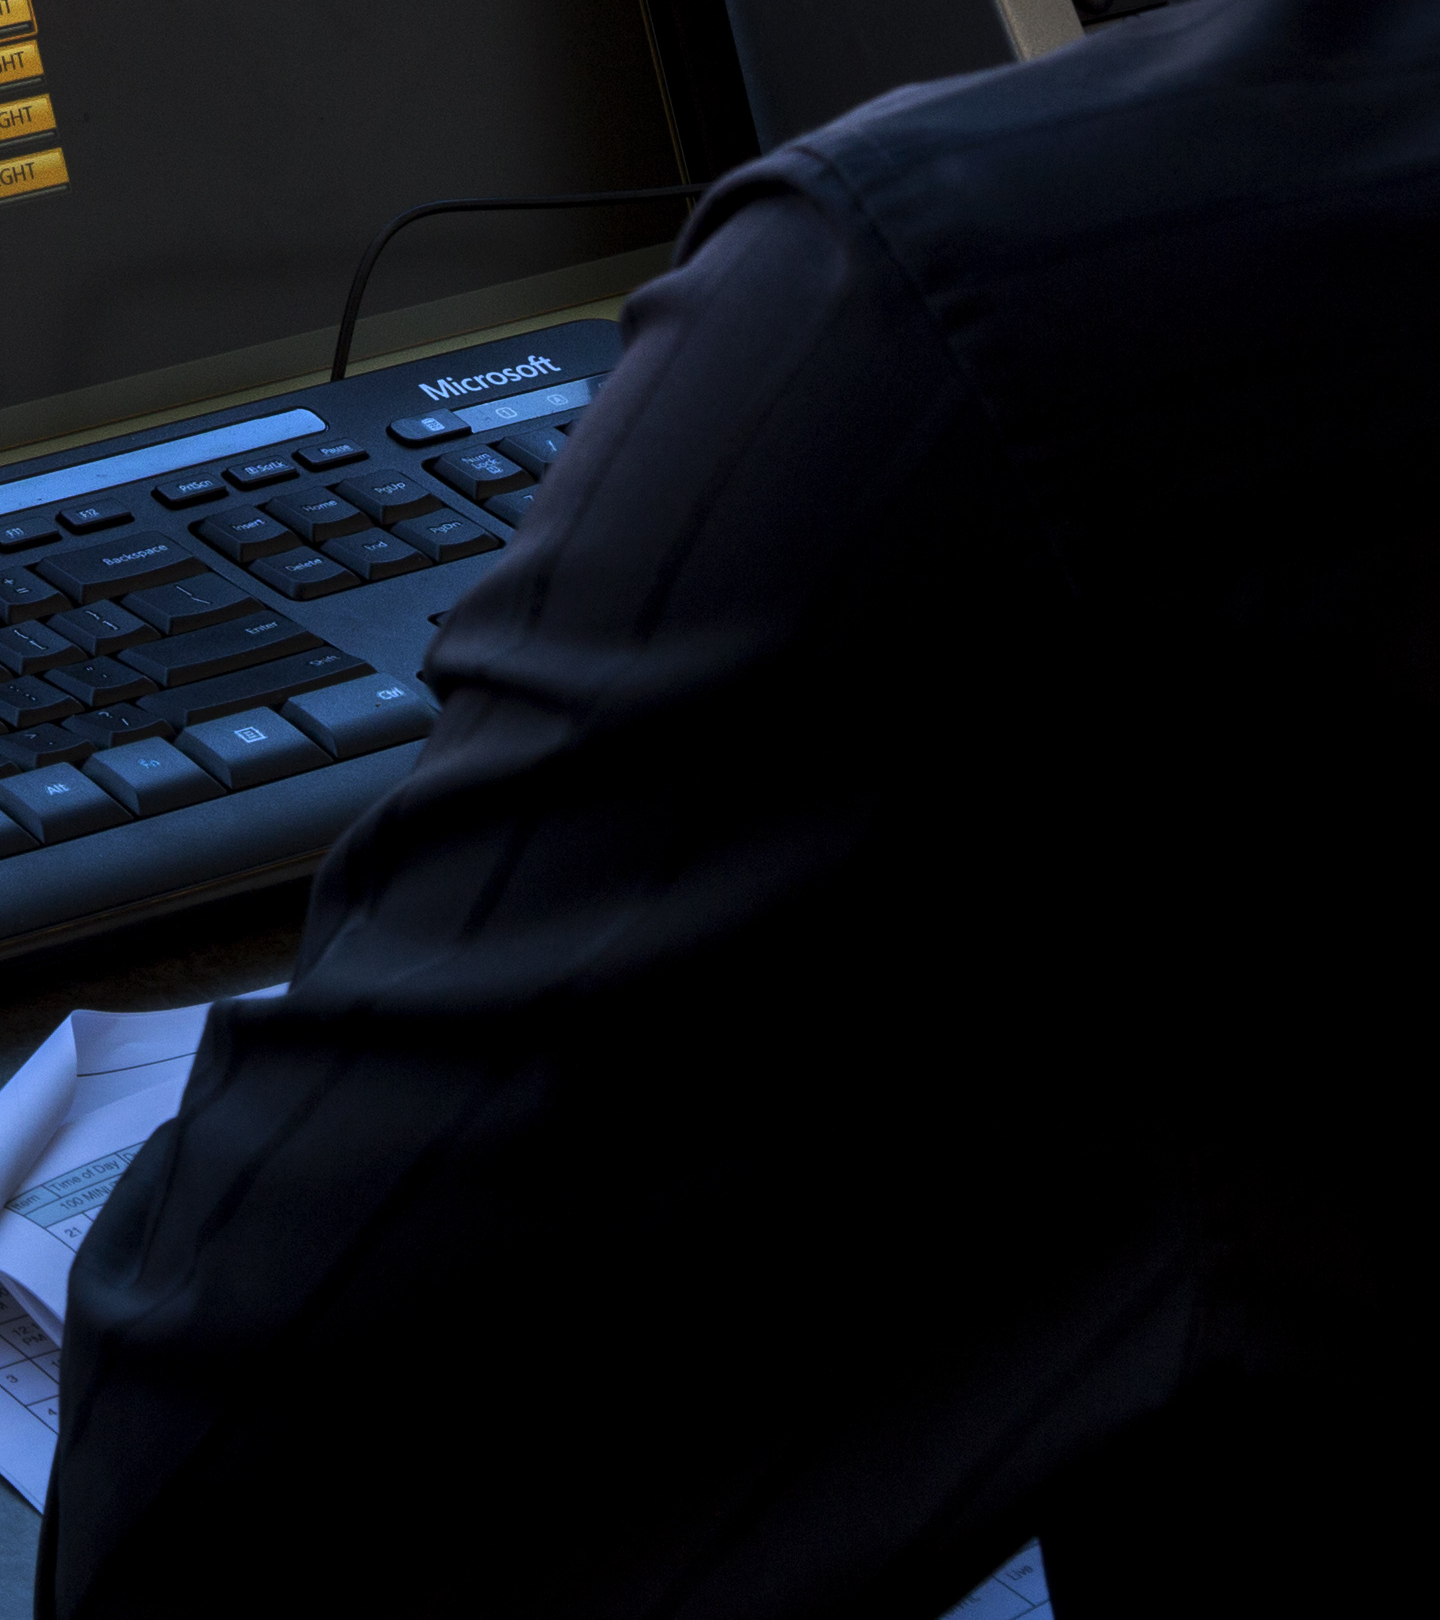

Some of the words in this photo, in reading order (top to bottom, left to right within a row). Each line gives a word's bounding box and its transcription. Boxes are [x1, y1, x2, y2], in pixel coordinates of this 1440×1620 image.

[418, 354, 561, 403] Microsoft
[303, 497, 338, 514] Home
[231, 518, 264, 533] Insert
[102, 543, 168, 567] Backspace
[286, 558, 323, 573] Delete
[245, 619, 278, 637] Enter
[377, 686, 406, 701] Ctrl
[45, 779, 70, 797] Alt
[51, 1174, 80, 1192] Time
[94, 1159, 120, 1175] Day
